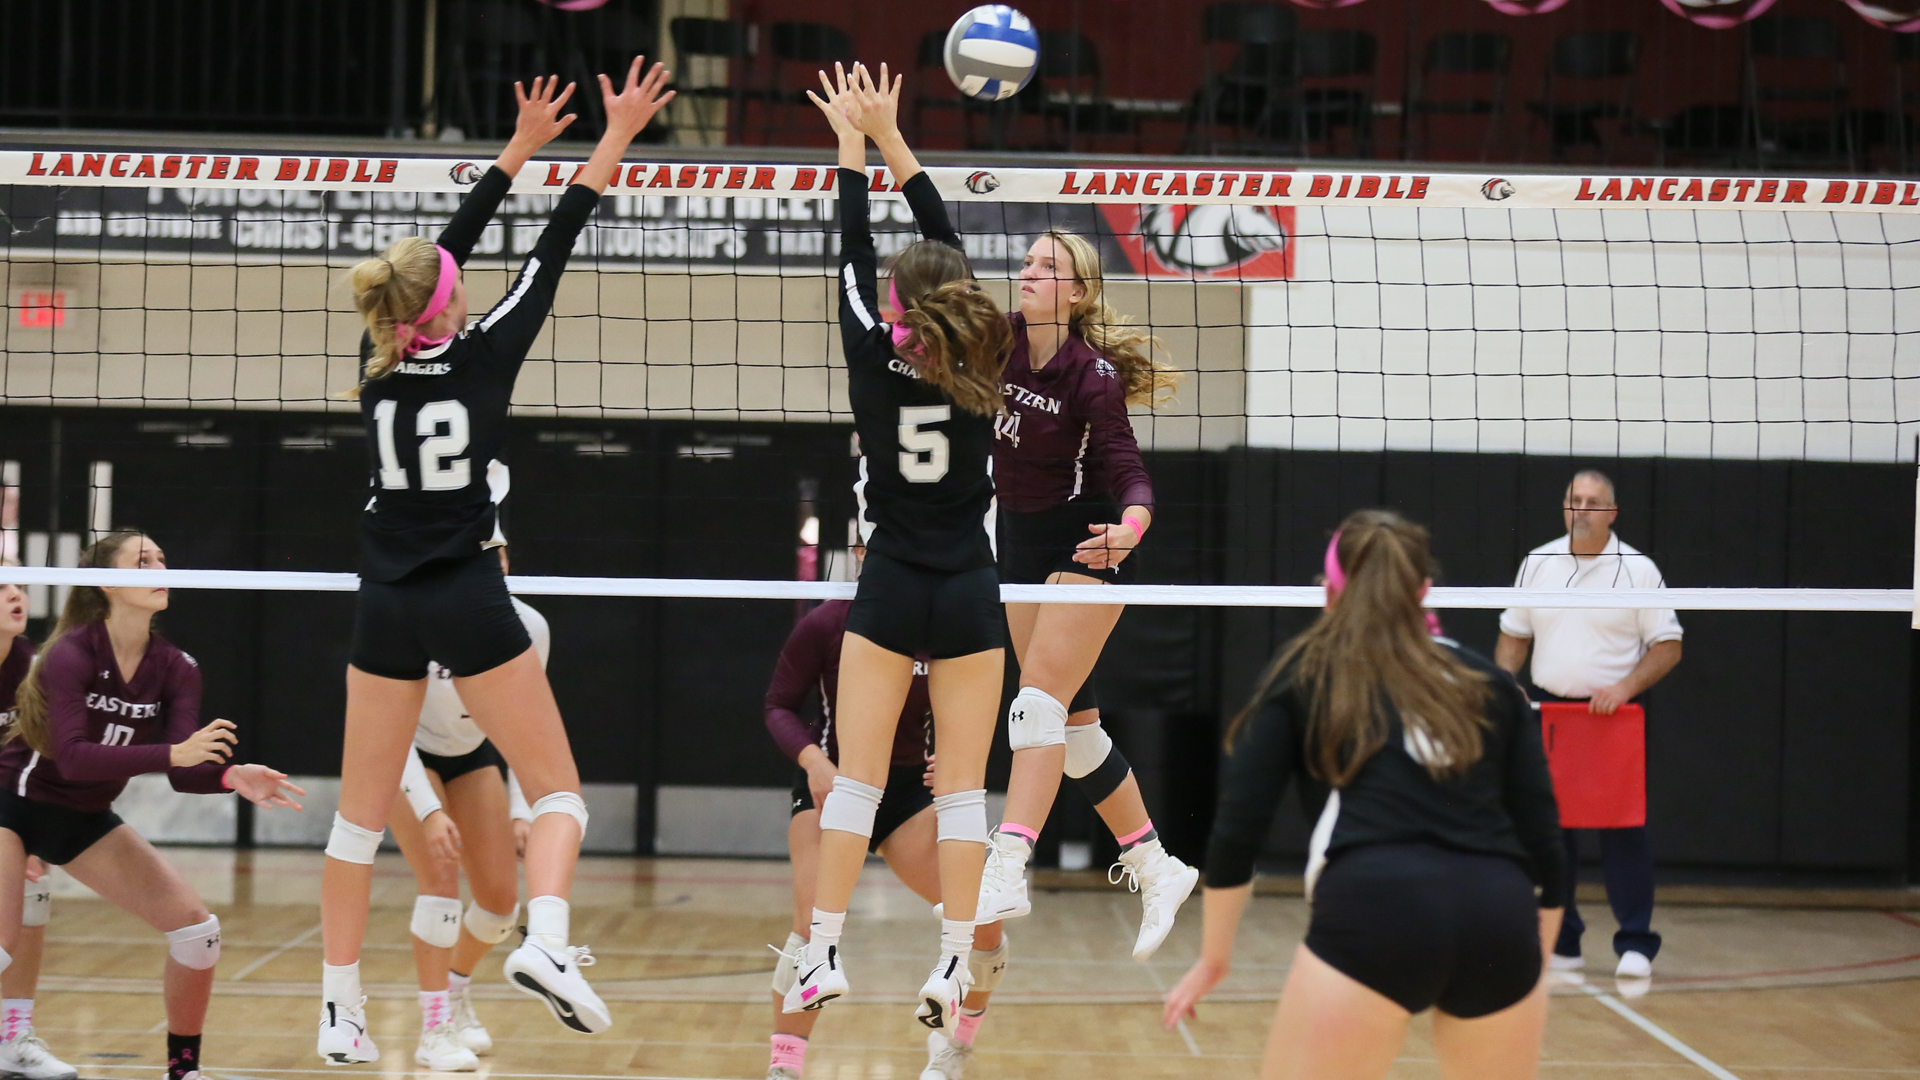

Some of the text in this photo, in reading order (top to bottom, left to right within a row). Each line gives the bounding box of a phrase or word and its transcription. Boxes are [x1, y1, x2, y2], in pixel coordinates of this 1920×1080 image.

[26, 152, 399, 184] LANCASTER BIBLE
[1059, 171, 1431, 200] LANCASTER BIBLE
[1574, 177, 1808, 203] LANCASTER
[373, 399, 471, 491] 12
[898, 405, 951, 483] 5
